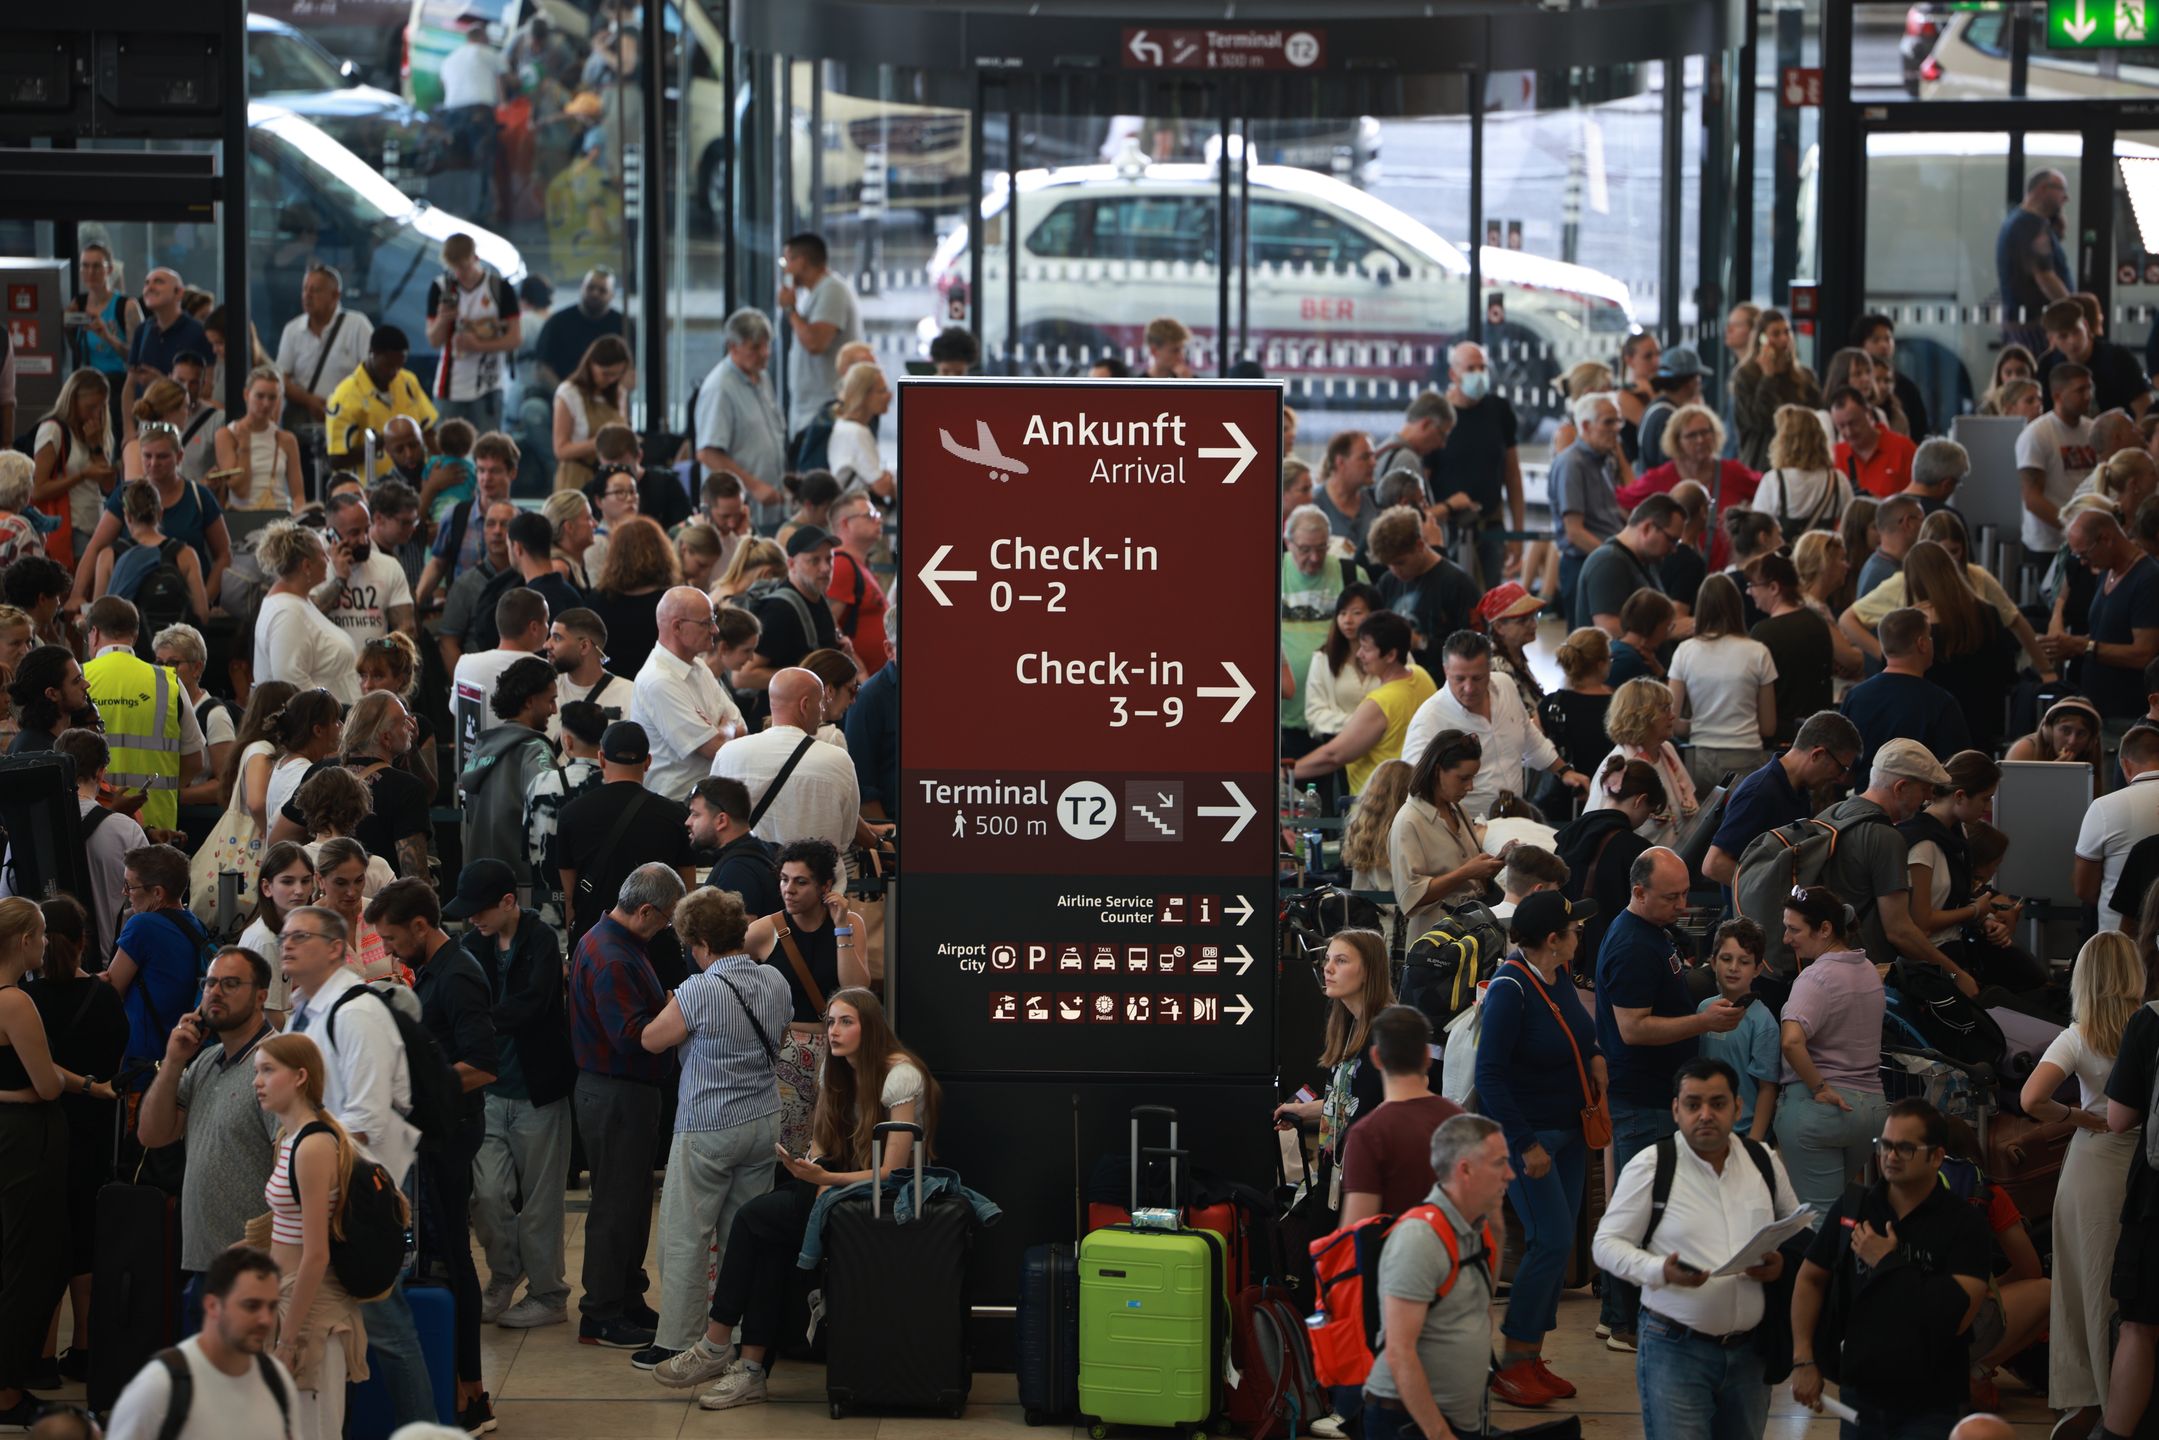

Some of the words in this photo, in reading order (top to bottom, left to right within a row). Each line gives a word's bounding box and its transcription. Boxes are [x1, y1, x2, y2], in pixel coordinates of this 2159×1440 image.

[1205, 30, 1283, 48] Terminal
[1302, 298, 1354, 320] BER
[1023, 412, 1186, 446] Ankunft
[1090, 457, 1186, 484] Arrival
[990, 537, 1158, 570] Check-in
[1016, 652, 1184, 685] Check-in
[92, 697, 139, 708] Eurowings
[920, 779, 1049, 804] Terminal
[1065, 796, 1107, 825] T2
[976, 816, 1018, 836] 500
[1027, 821, 1047, 835] m
[1057, 895, 1102, 907] Airline
[1105, 895, 1154, 908] Service
[1100, 911, 1154, 923] Counter
[938, 943, 986, 958] Airport
[1029, 945, 1046, 970] P
[959, 958, 986, 974] City
